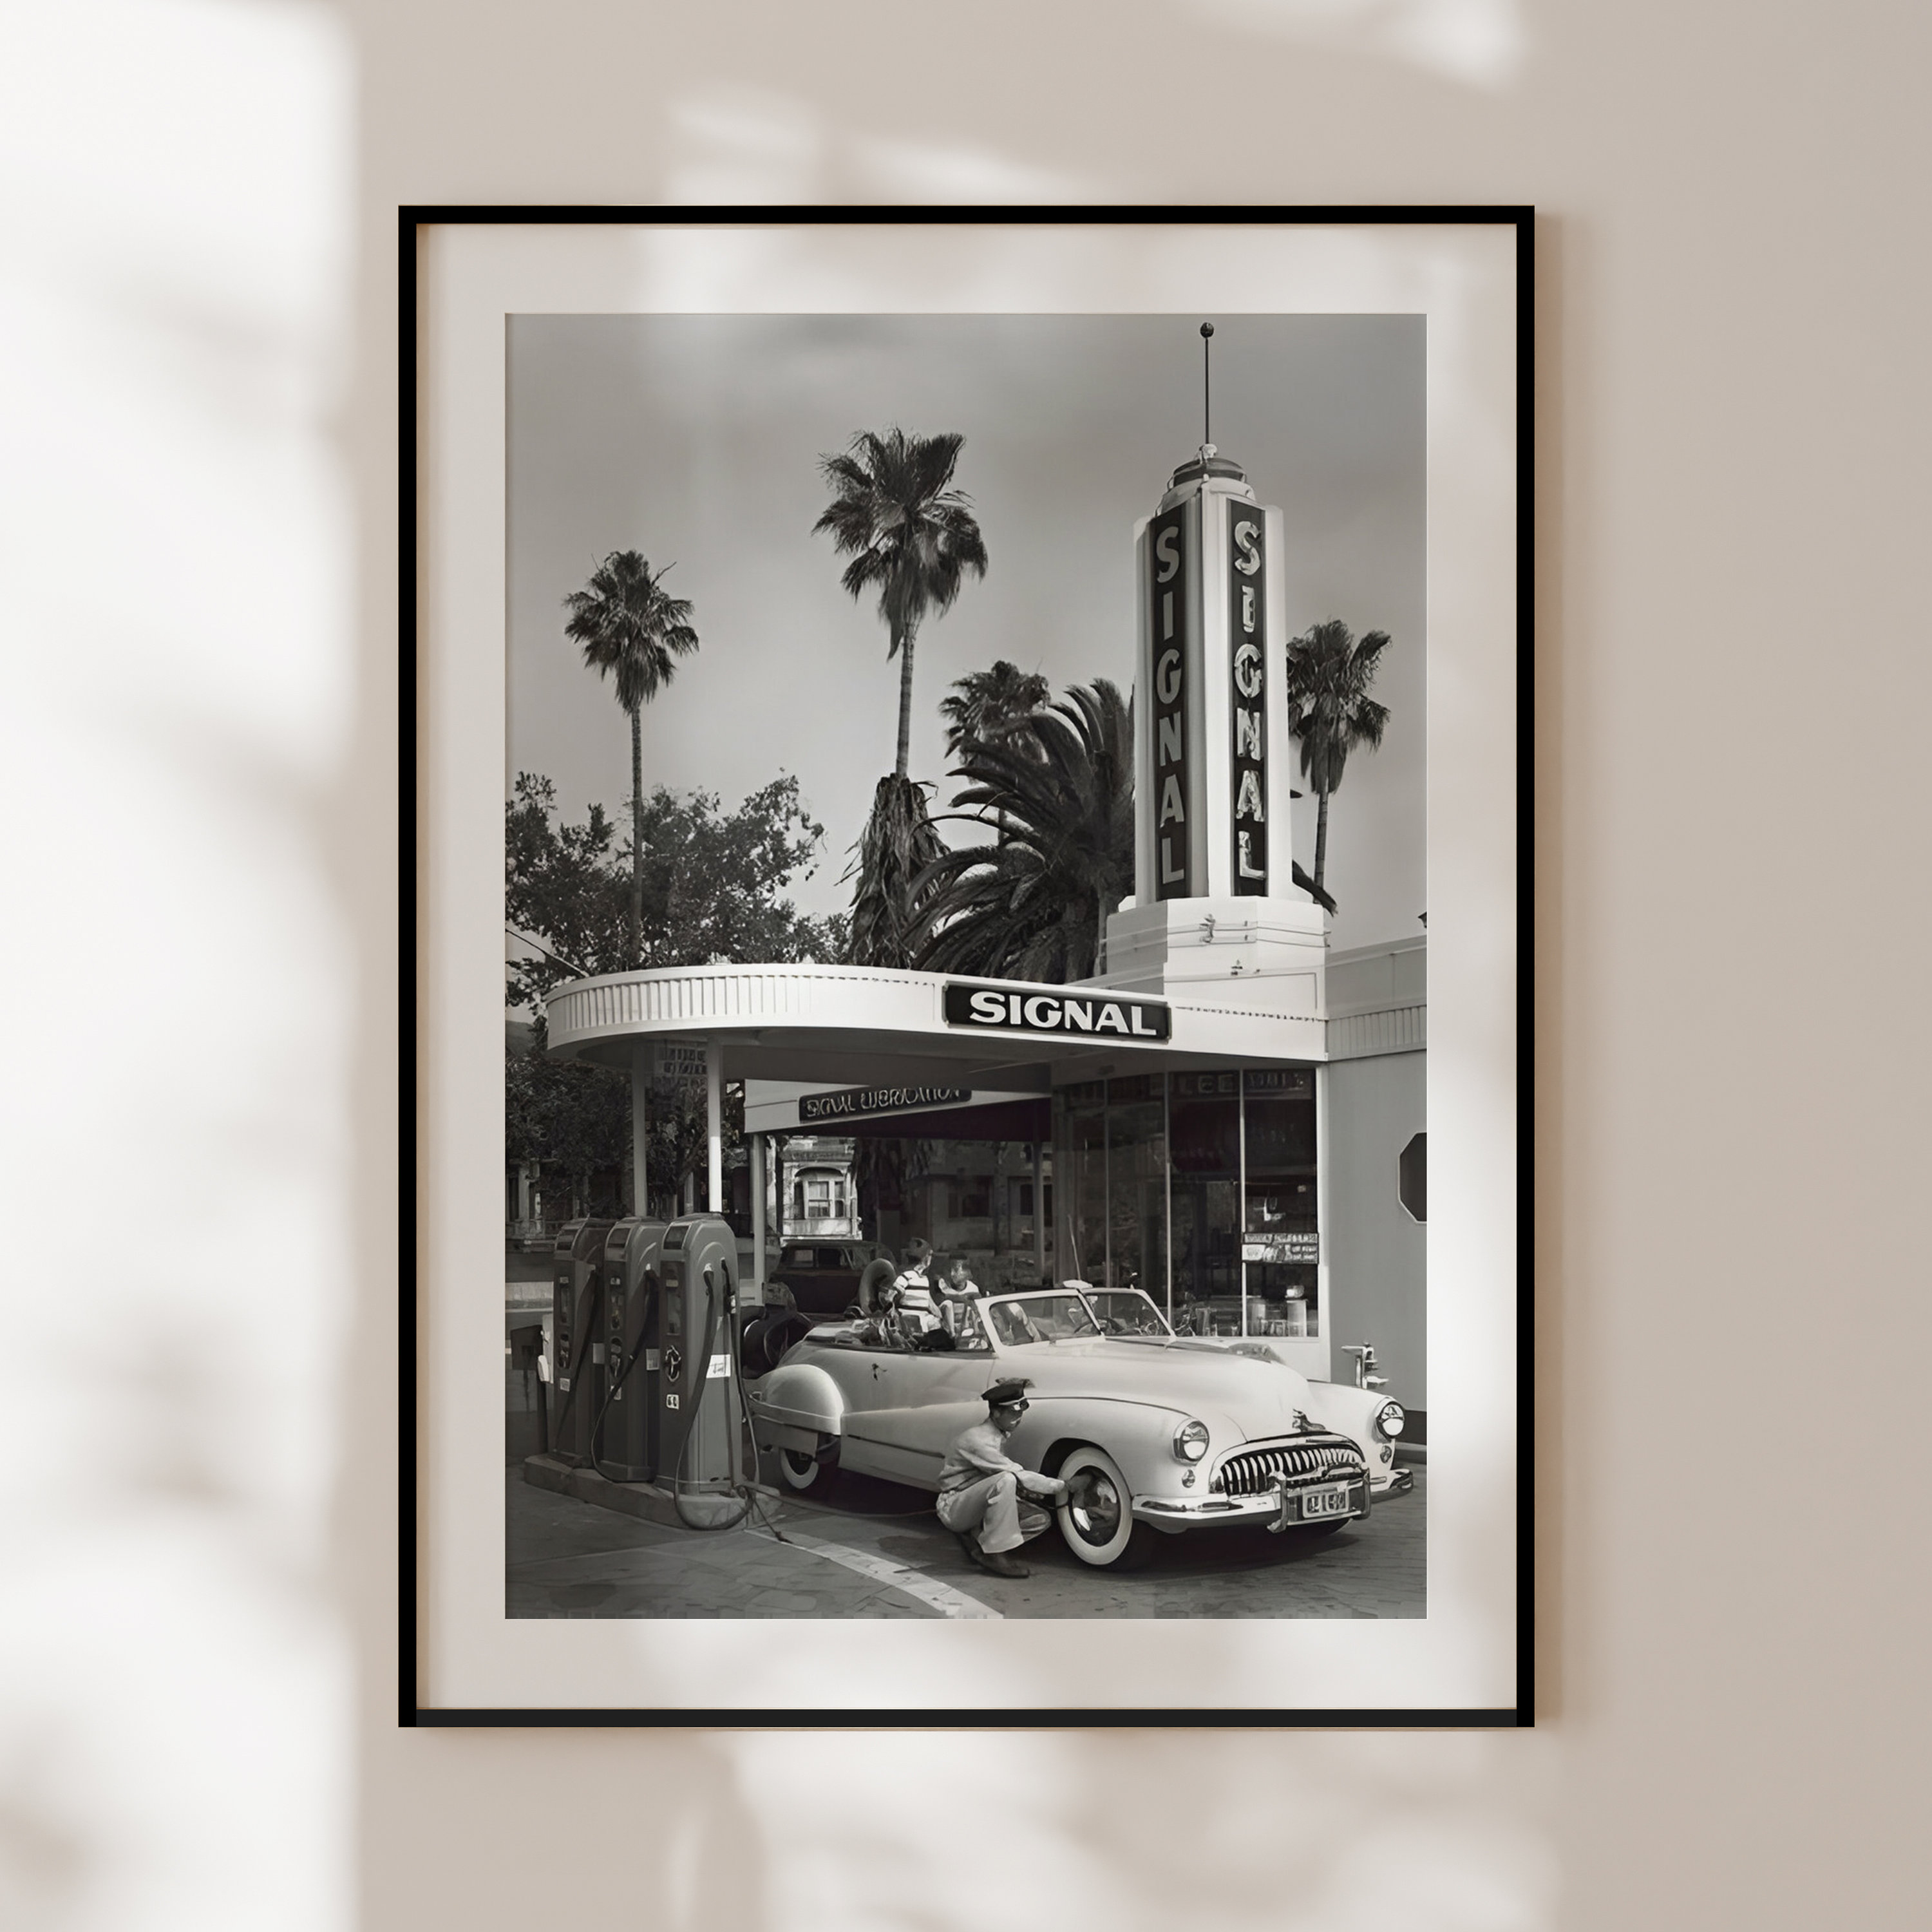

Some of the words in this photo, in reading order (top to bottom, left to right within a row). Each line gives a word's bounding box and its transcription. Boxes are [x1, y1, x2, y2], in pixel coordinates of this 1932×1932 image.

[1156, 526, 1185, 884] SIGNAL
[1233, 520, 1266, 880] SIGNAL
[969, 991, 1157, 1036] SIGNAL
